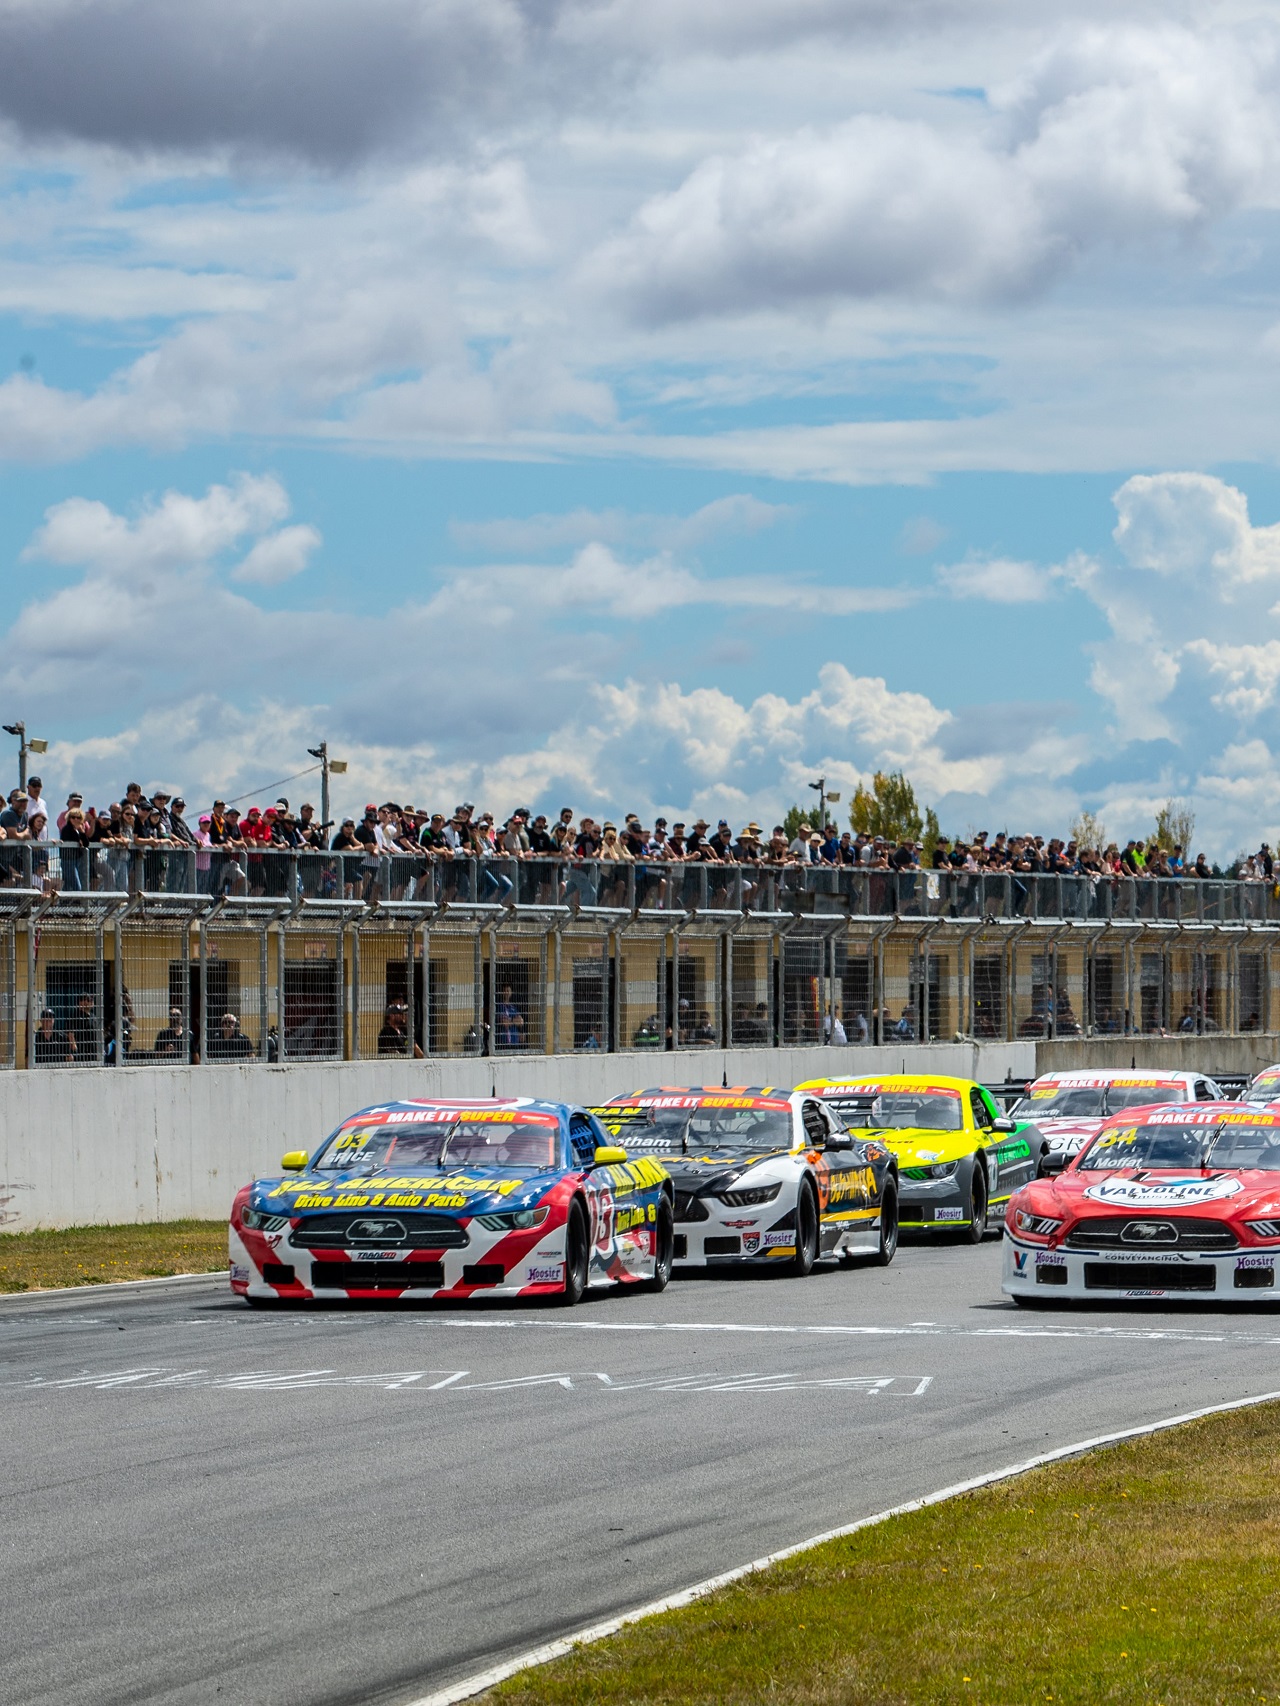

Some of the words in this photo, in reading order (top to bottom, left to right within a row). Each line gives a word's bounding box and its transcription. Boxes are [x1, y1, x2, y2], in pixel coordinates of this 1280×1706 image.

[1058, 1080, 1096, 1088] MAKE
[1097, 1079, 1110, 1087] IT
[1113, 1079, 1157, 1088] SUPER
[823, 1085, 863, 1095] MAKE
[864, 1085, 880, 1093] IT
[881, 1085, 928, 1093] SUPER
[1031, 1089, 1059, 1100] 99
[637, 1097, 682, 1108] MAKE
[683, 1096, 702, 1107] IT
[702, 1097, 755, 1108] SUPER
[386, 1111, 438, 1123] MAKE
[438, 1111, 458, 1121] IT
[459, 1110, 516, 1122] SUPER
[1013, 1108, 1060, 1118] Holdsworth
[1147, 1113, 1199, 1125] MAKE
[1199, 1113, 1216, 1123] IT
[1217, 1114, 1274, 1125] SUPER
[335, 1133, 370, 1149] 03
[1099, 1128, 1138, 1148] 34
[323, 1151, 376, 1164] GRICE
[1094, 1157, 1143, 1168] Moffat
[268, 1179, 334, 1198] ALL
[335, 1176, 524, 1197] AMERICAN
[1099, 1185, 1216, 1197] VALVOLINE
[294, 1194, 334, 1210] Drive
[333, 1194, 367, 1208] Line
[371, 1194, 382, 1207] &
[384, 1193, 421, 1207] Auto
[424, 1193, 467, 1208] Parts
[936, 1209, 962, 1220] Hoosier
[747, 1240, 757, 1250] 29
[763, 1233, 793, 1246] Hoosier
[1035, 1251, 1065, 1265] Hoosier
[1105, 1254, 1180, 1262] CONVEYANCING
[1236, 1256, 1275, 1269] Hoosier
[527, 1267, 561, 1281] Hoosier
